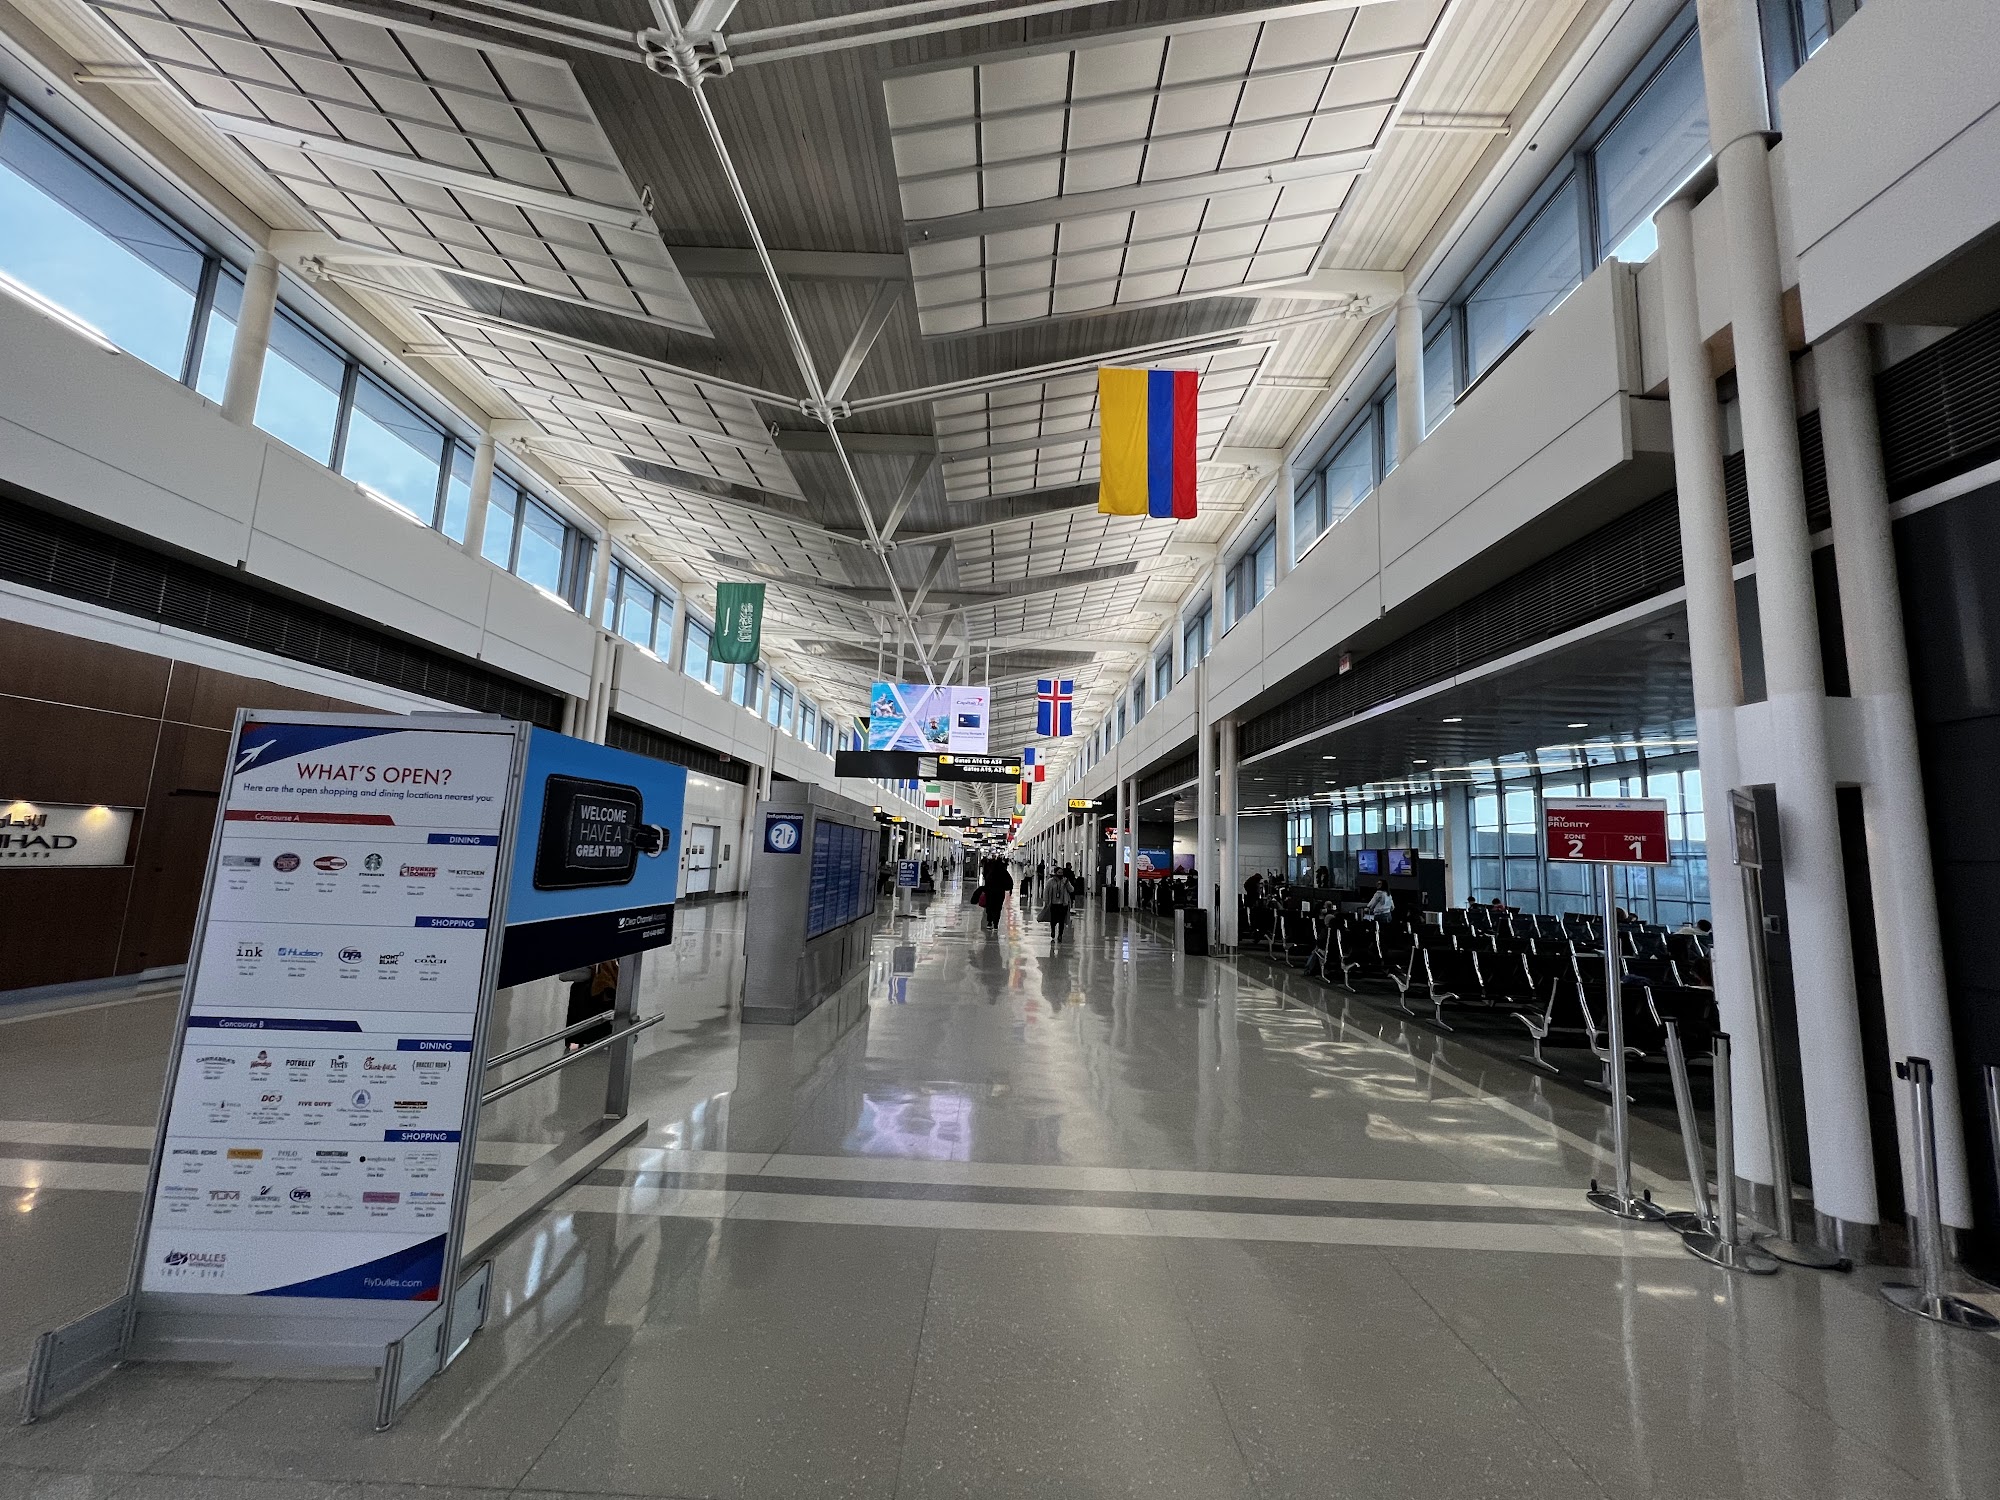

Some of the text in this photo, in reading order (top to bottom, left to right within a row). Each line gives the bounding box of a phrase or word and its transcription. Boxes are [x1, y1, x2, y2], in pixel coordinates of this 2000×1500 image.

[297, 762, 452, 786] WHAT'S OPEN?
[243, 783, 263, 792] Here
[265, 785, 279, 793] are
[281, 784, 294, 793] the
[296, 786, 317, 796] open
[320, 786, 358, 798] shopping
[361, 789, 377, 797] and
[379, 789, 404, 800] dining
[406, 790, 442, 800] locations
[255, 813, 292, 821] Concourse
[581, 804, 627, 824] WELCOME
[580, 823, 622, 843] HAVE A
[449, 836, 481, 844] DINING
[576, 844, 624, 858] GREAT TRIP
[1568, 840, 1584, 857] 2
[1628, 841, 1643, 860] 1
[431, 919, 475, 927] SHOPPING
[236, 946, 263, 957] ink
[287, 948, 324, 957] Hudson
[219, 1019, 264, 1029] Concourse B
[420, 1042, 453, 1050] DINING
[285, 1059, 316, 1067] POTBELLY
[401, 1132, 447, 1141] SHOPPING
[189, 1253, 226, 1262] DULLES
[363, 1277, 422, 1287] FlyDulles.com
